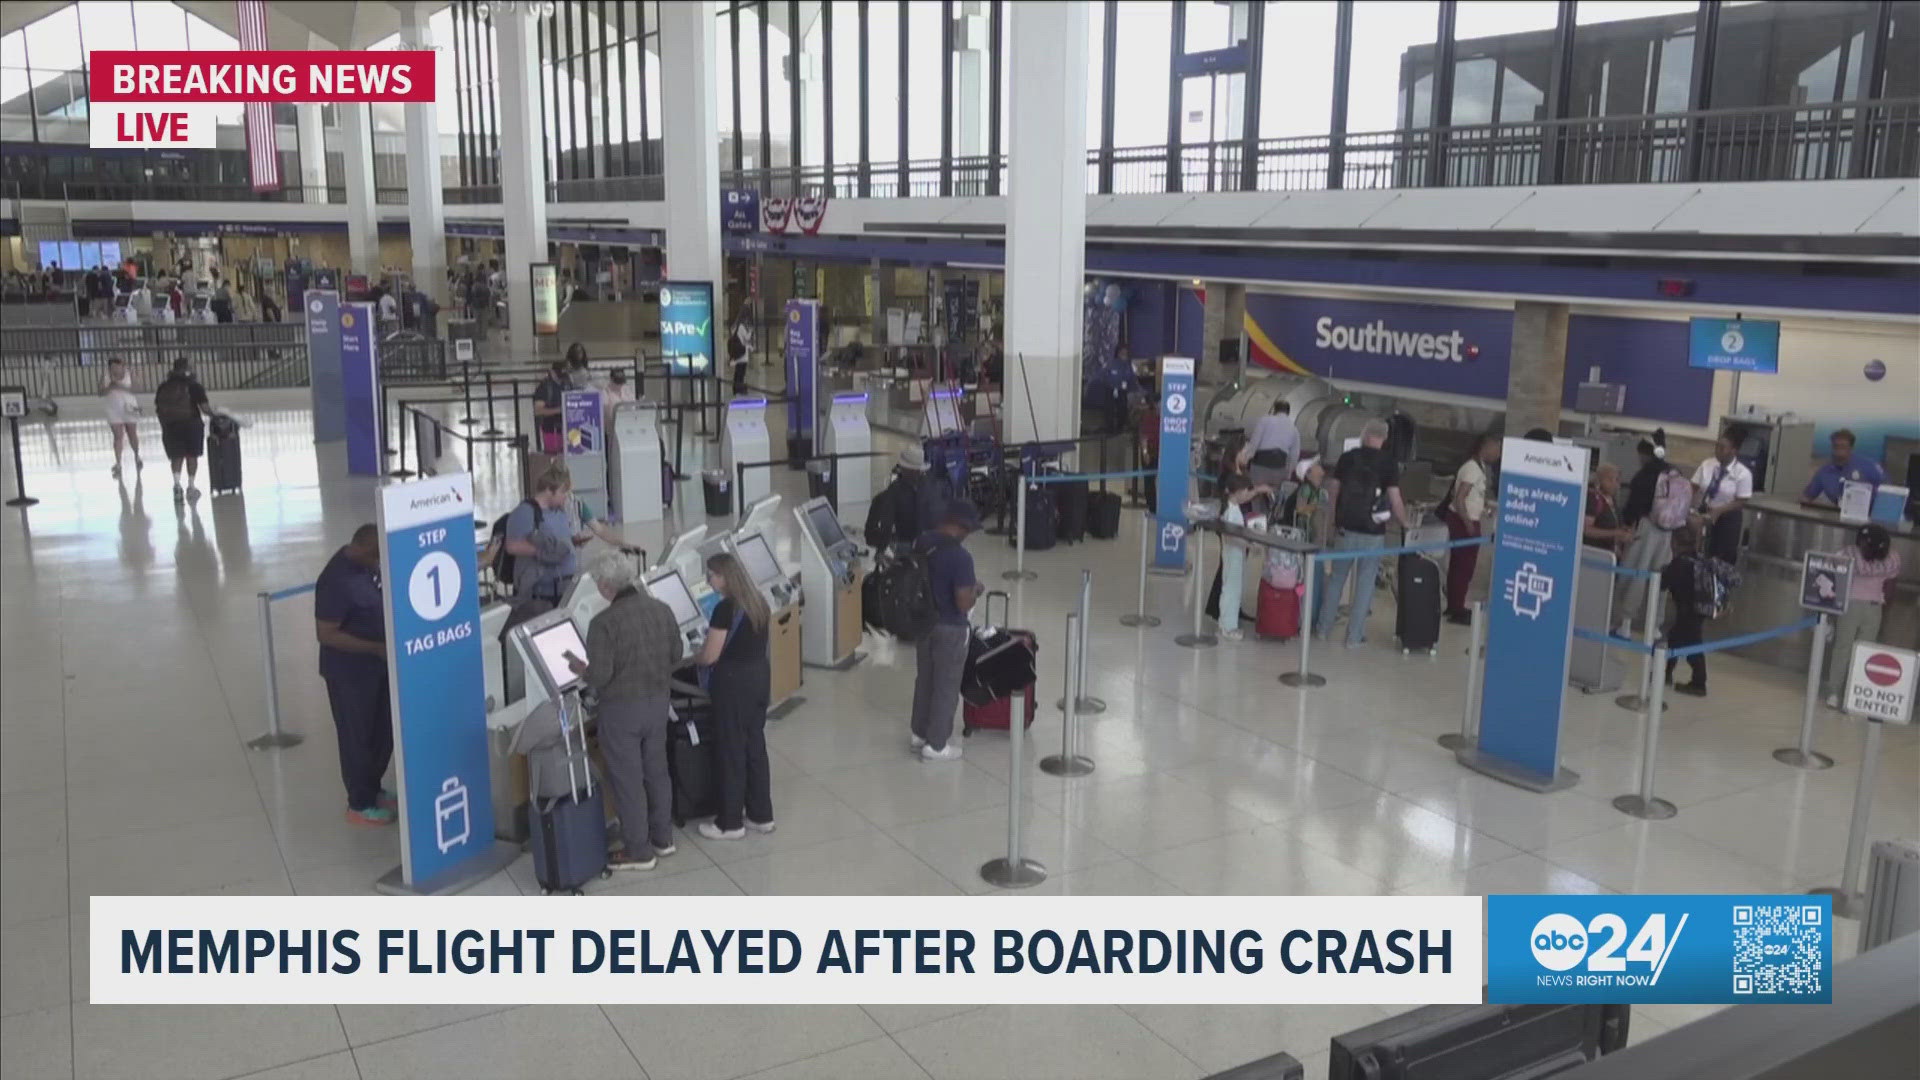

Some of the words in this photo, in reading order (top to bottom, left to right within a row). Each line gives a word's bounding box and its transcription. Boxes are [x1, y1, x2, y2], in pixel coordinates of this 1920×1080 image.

[675, 321, 695, 335] Pre
[1316, 316, 1464, 362] Southwest
[1728, 335, 1737, 349] 2
[1708, 355, 1732, 364] DROP
[1733, 356, 1755, 365] BAGS
[1168, 383, 1187, 391] STEP
[1173, 397, 1180, 411] 2
[1164, 424, 1186, 432] BAGS
[1524, 453, 1562, 466] American
[410, 493, 450, 510] American
[1507, 483, 1529, 498] Bags
[1531, 488, 1568, 507] already
[1506, 500, 1535, 513] added
[1505, 514, 1539, 528] online?
[418, 528, 447, 548] STEP
[426, 564, 441, 607] 1
[405, 634, 434, 656] TAG
[437, 621, 472, 646] BAGS
[1853, 685, 1873, 697] DO
[1876, 689, 1904, 703] NOT
[1854, 698, 1900, 716] ENTER
